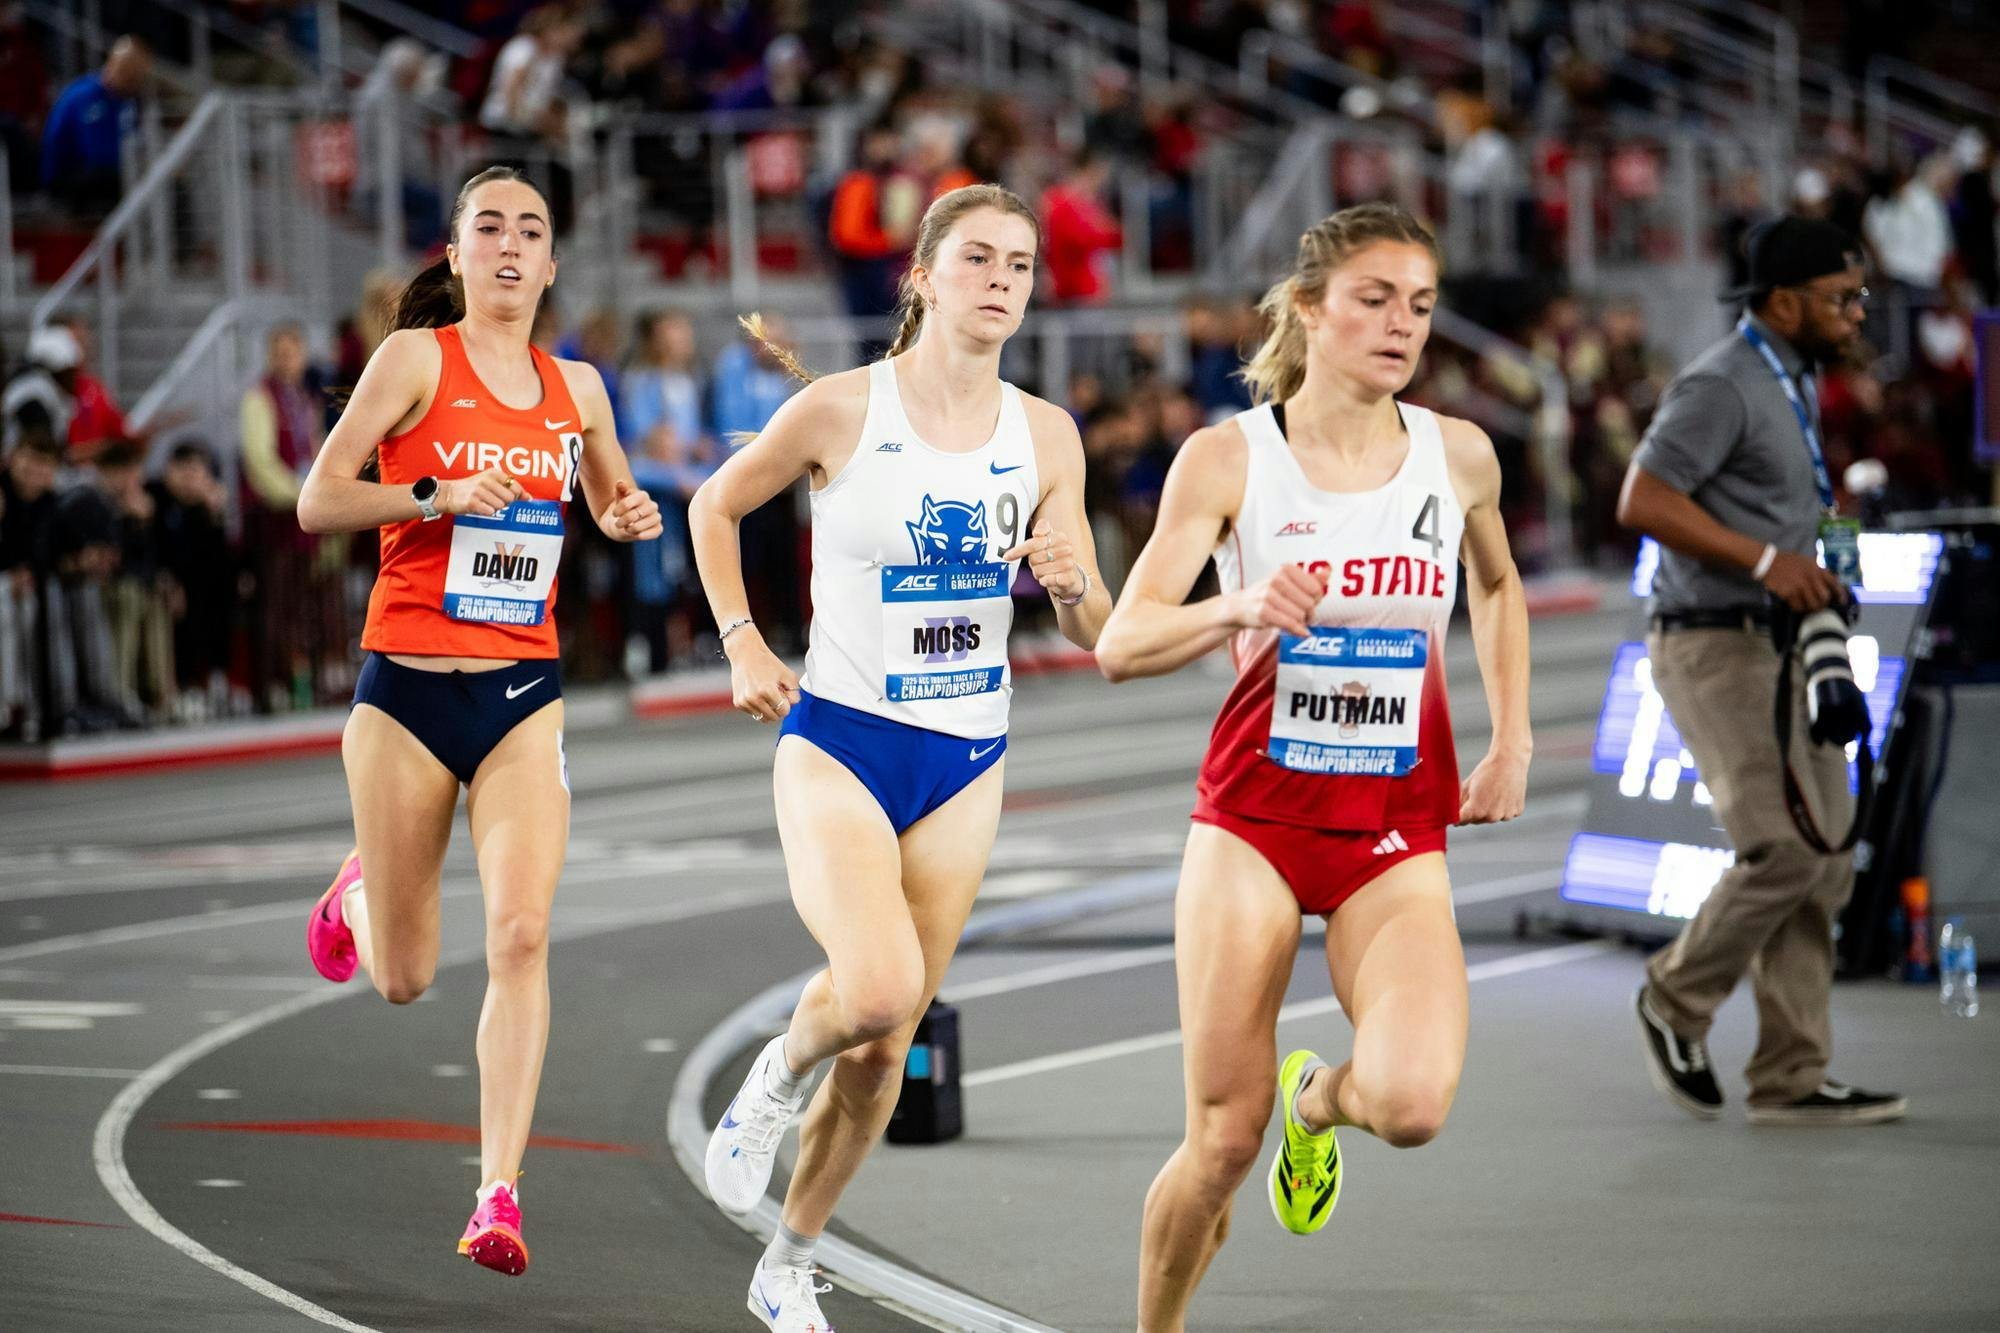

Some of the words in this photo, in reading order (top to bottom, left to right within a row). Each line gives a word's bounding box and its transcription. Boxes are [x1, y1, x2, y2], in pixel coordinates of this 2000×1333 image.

[450, 399, 477, 408] ACC
[876, 443, 904, 452] ACC
[515, 513, 558, 526] GREATNESS
[996, 492, 1019, 558] 9
[1275, 521, 1318, 537] ACC
[1412, 493, 1444, 559] 4
[472, 552, 539, 582] DAVID
[1341, 555, 1446, 598] STATE
[891, 574, 940, 592] ACC
[951, 577, 998, 590] GREATNESS
[456, 605, 537, 624] CHAMPIONSHIPS
[913, 624, 981, 655] MOSS
[1290, 636, 1345, 656] ACC
[918, 676, 929, 685] ACC
[953, 673, 968, 683] TRACK
[974, 671, 989, 680] FIELD
[901, 679, 988, 700] CHAMPIONSHIPS
[1290, 692, 1406, 725] PUTMAN
[1285, 751, 1396, 774] CHAMPIONSHIPS
